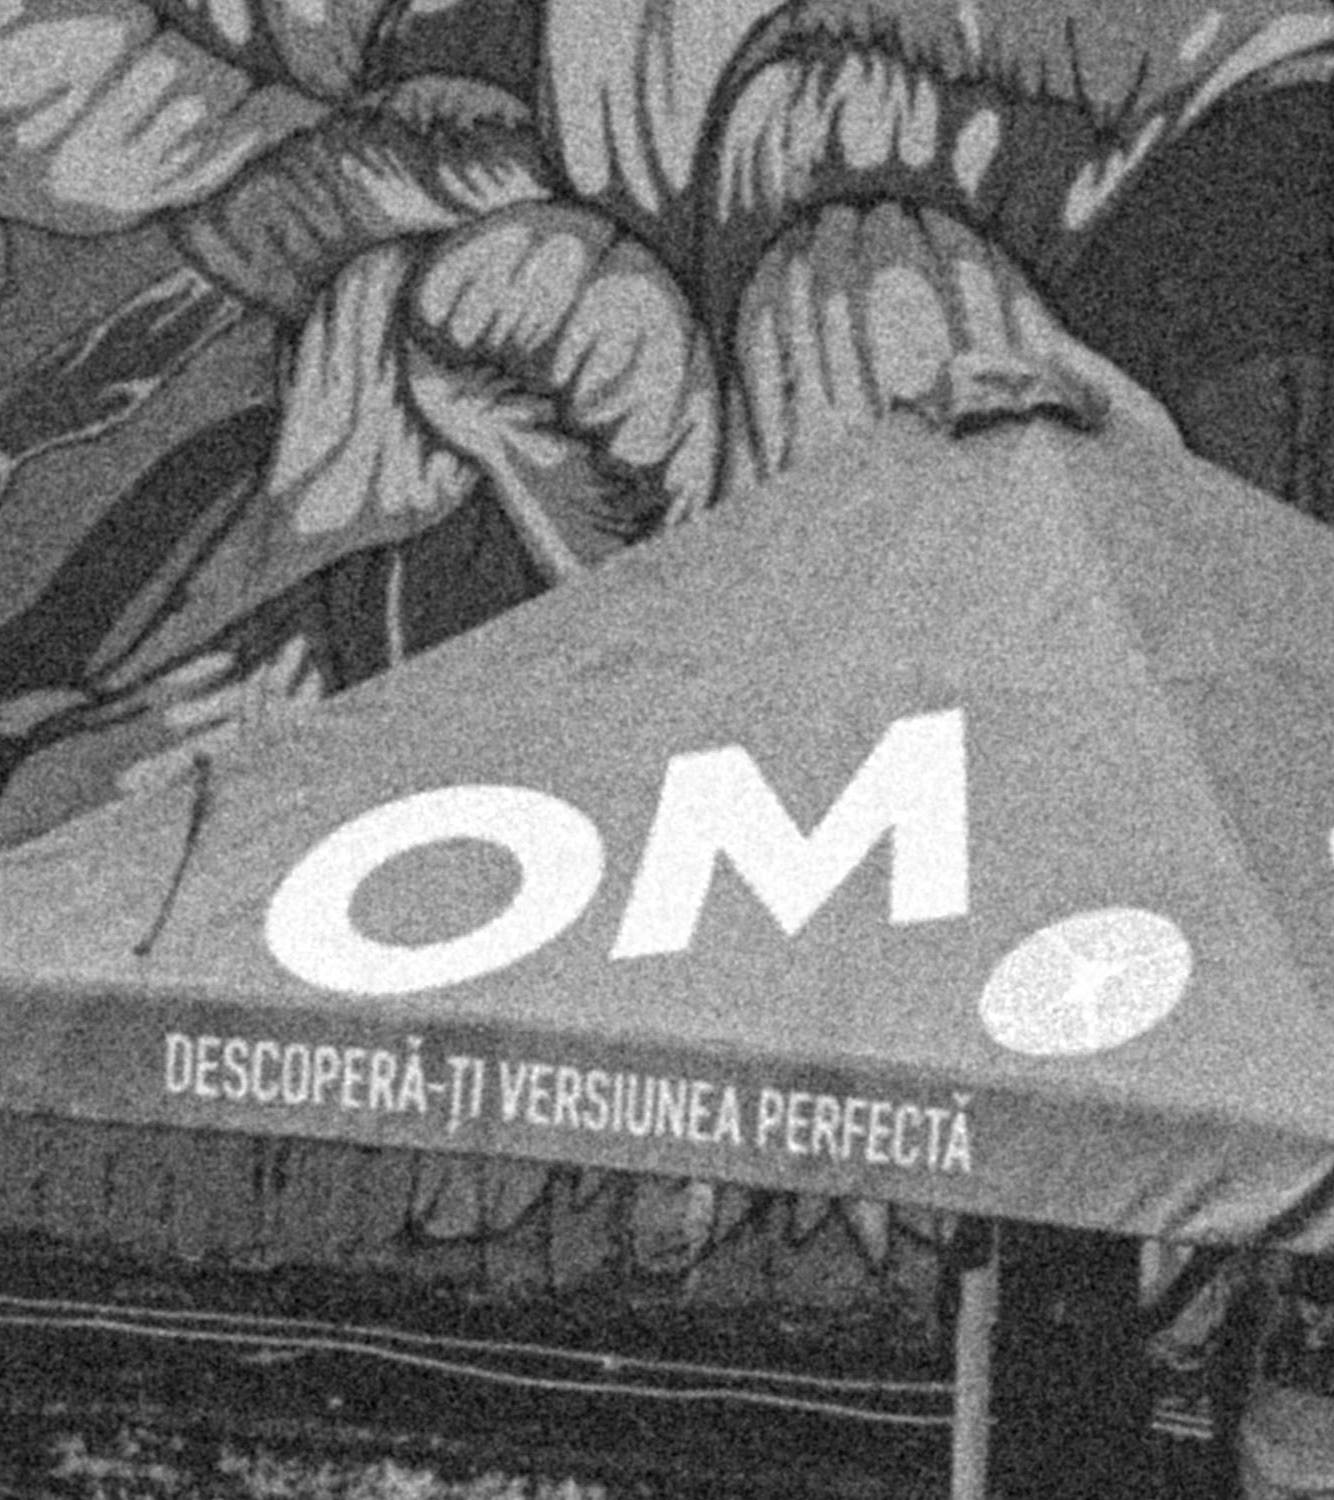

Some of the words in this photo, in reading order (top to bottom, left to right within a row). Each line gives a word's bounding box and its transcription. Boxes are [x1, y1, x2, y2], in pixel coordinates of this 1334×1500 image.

[266, 707, 968, 996] OM
[500, 1060, 742, 1145] VERSIUNEA
[757, 1086, 971, 1172] PERFECTĂ
